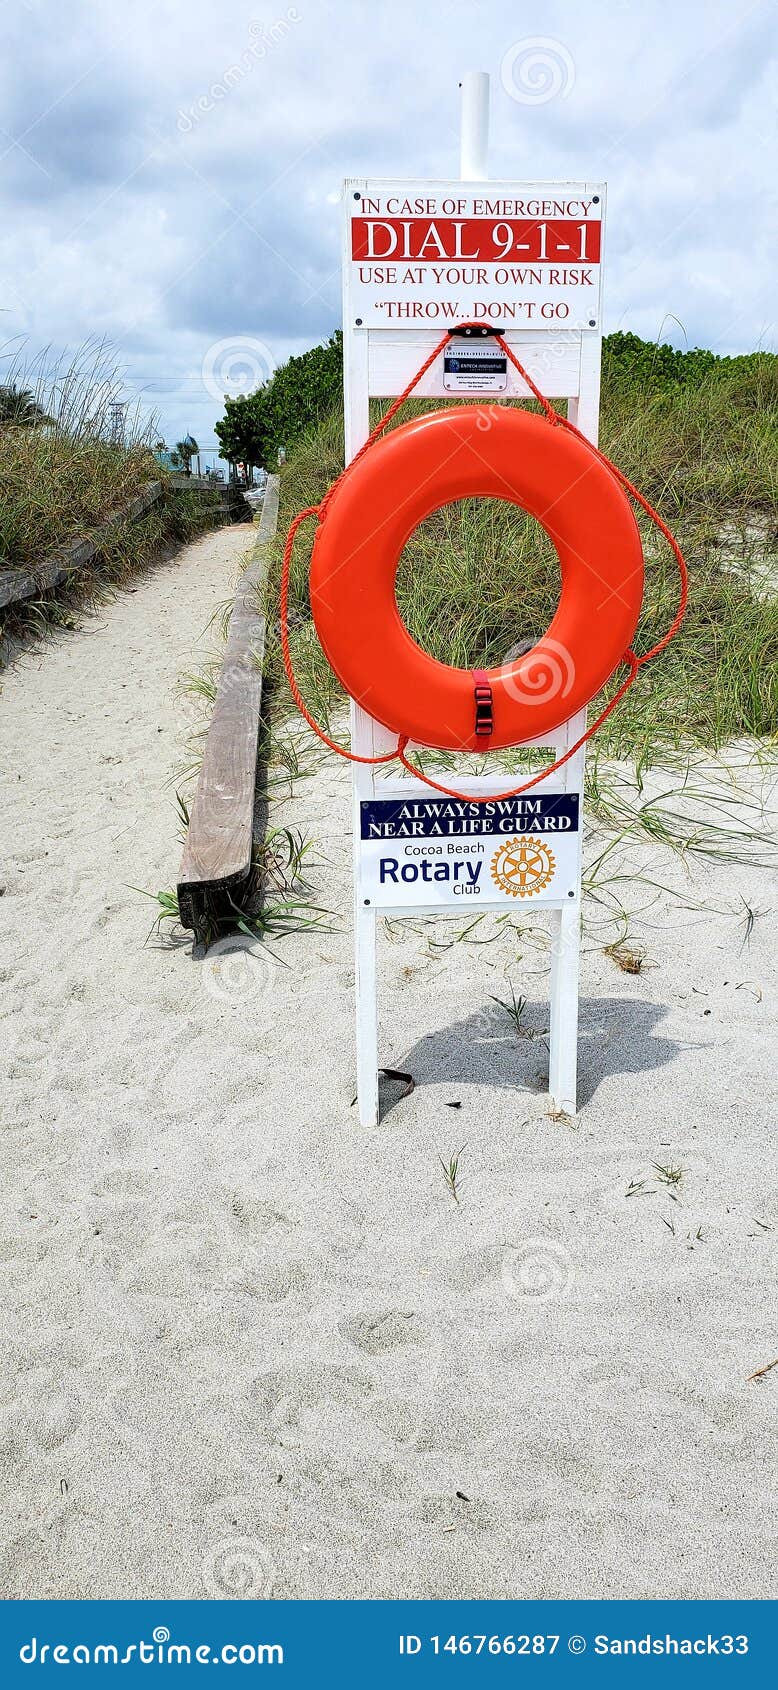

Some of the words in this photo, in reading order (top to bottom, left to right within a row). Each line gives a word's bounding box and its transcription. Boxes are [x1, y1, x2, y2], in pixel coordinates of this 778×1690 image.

[361, 198, 381, 214] IN
[386, 198, 437, 215] CASE
[442, 199, 467, 215] OF
[473, 199, 592, 217] EMERGENCY
[363, 221, 480, 259] DIAL
[492, 222, 590, 260] 9-1-1
[359, 268, 397, 284] USE
[402, 268, 427, 284] AT
[432, 268, 489, 285] YOUR
[494, 268, 542, 285] OWN
[548, 269, 594, 286] RISK
[540, 303, 570, 319] GO
[398, 802, 480, 819] ALWAYS
[485, 800, 542, 816] SWIM
[368, 821, 426, 838] NEAR
[429, 821, 444, 835] A
[447, 819, 494, 834] LIFE
[498, 816, 572, 833] GUARD
[404, 845, 443, 856] Cocoa
[447, 842, 485, 854] Beach
[509, 843, 537, 851] ROTARY
[379, 858, 483, 886] Rotary
[453, 884, 481, 895] Club
[500, 875, 546, 891] INTERNATIONAL
